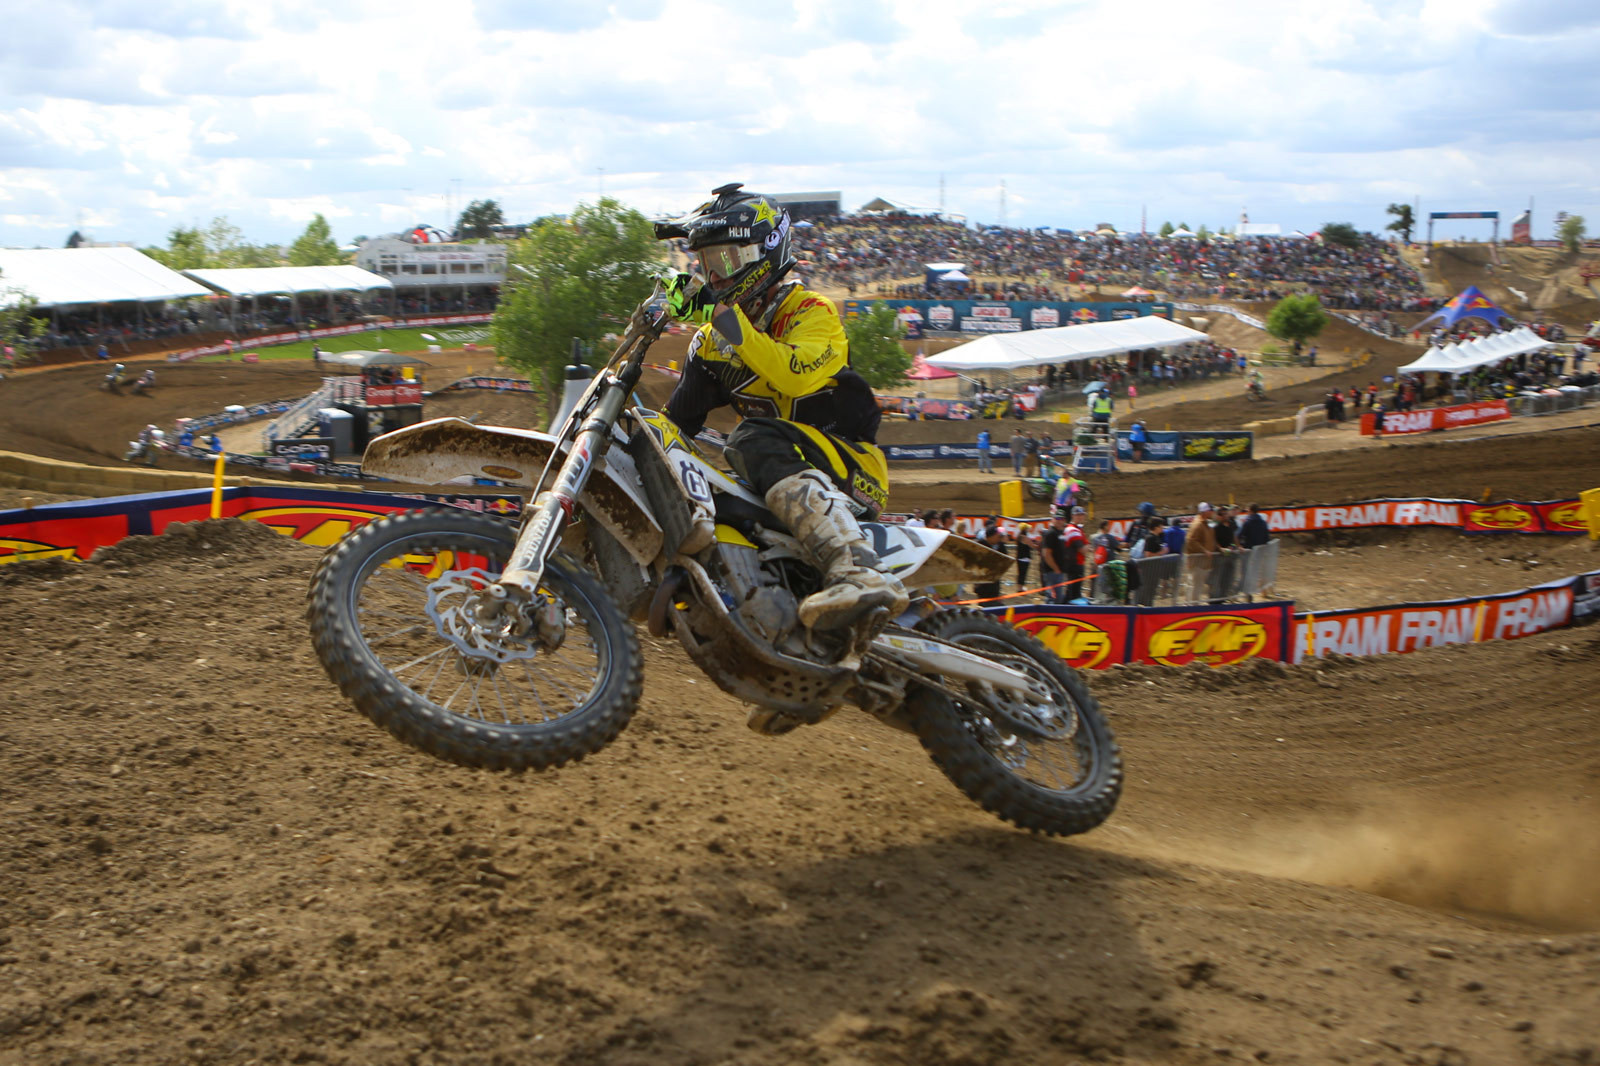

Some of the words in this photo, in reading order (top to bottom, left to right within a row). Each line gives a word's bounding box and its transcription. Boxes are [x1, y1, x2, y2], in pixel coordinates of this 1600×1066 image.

[276, 444, 331, 454] GoPro
[1314, 504, 1389, 527] FRAM
[1393, 503, 1459, 523] FRAM
[525, 510, 553, 558] DUNLOP
[1033, 625, 1108, 659] MF
[1149, 622, 1264, 657] FMF
[1293, 615, 1392, 664] FRAM
[1397, 605, 1489, 651] FRAM
[1494, 590, 1571, 639] FRAM
